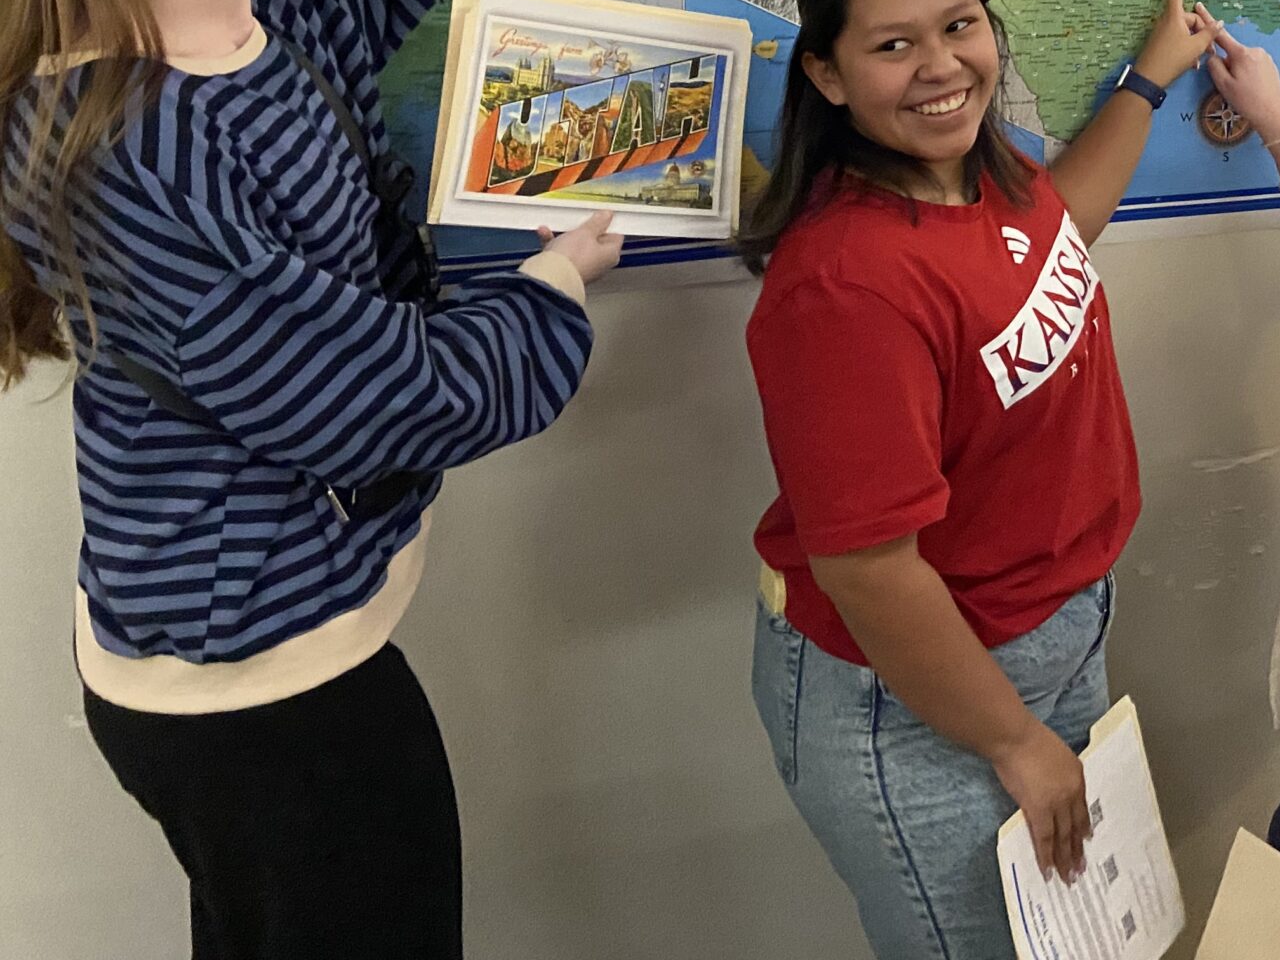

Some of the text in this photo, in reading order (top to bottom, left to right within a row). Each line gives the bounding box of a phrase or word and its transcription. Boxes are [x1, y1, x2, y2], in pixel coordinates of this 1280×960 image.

[492, 28, 583, 57] Greetings from
[487, 53, 717, 189] UTAH
[1180, 112, 1194, 122] W
[1222, 152, 1229, 162] S
[989, 234, 1093, 398] KANSA
